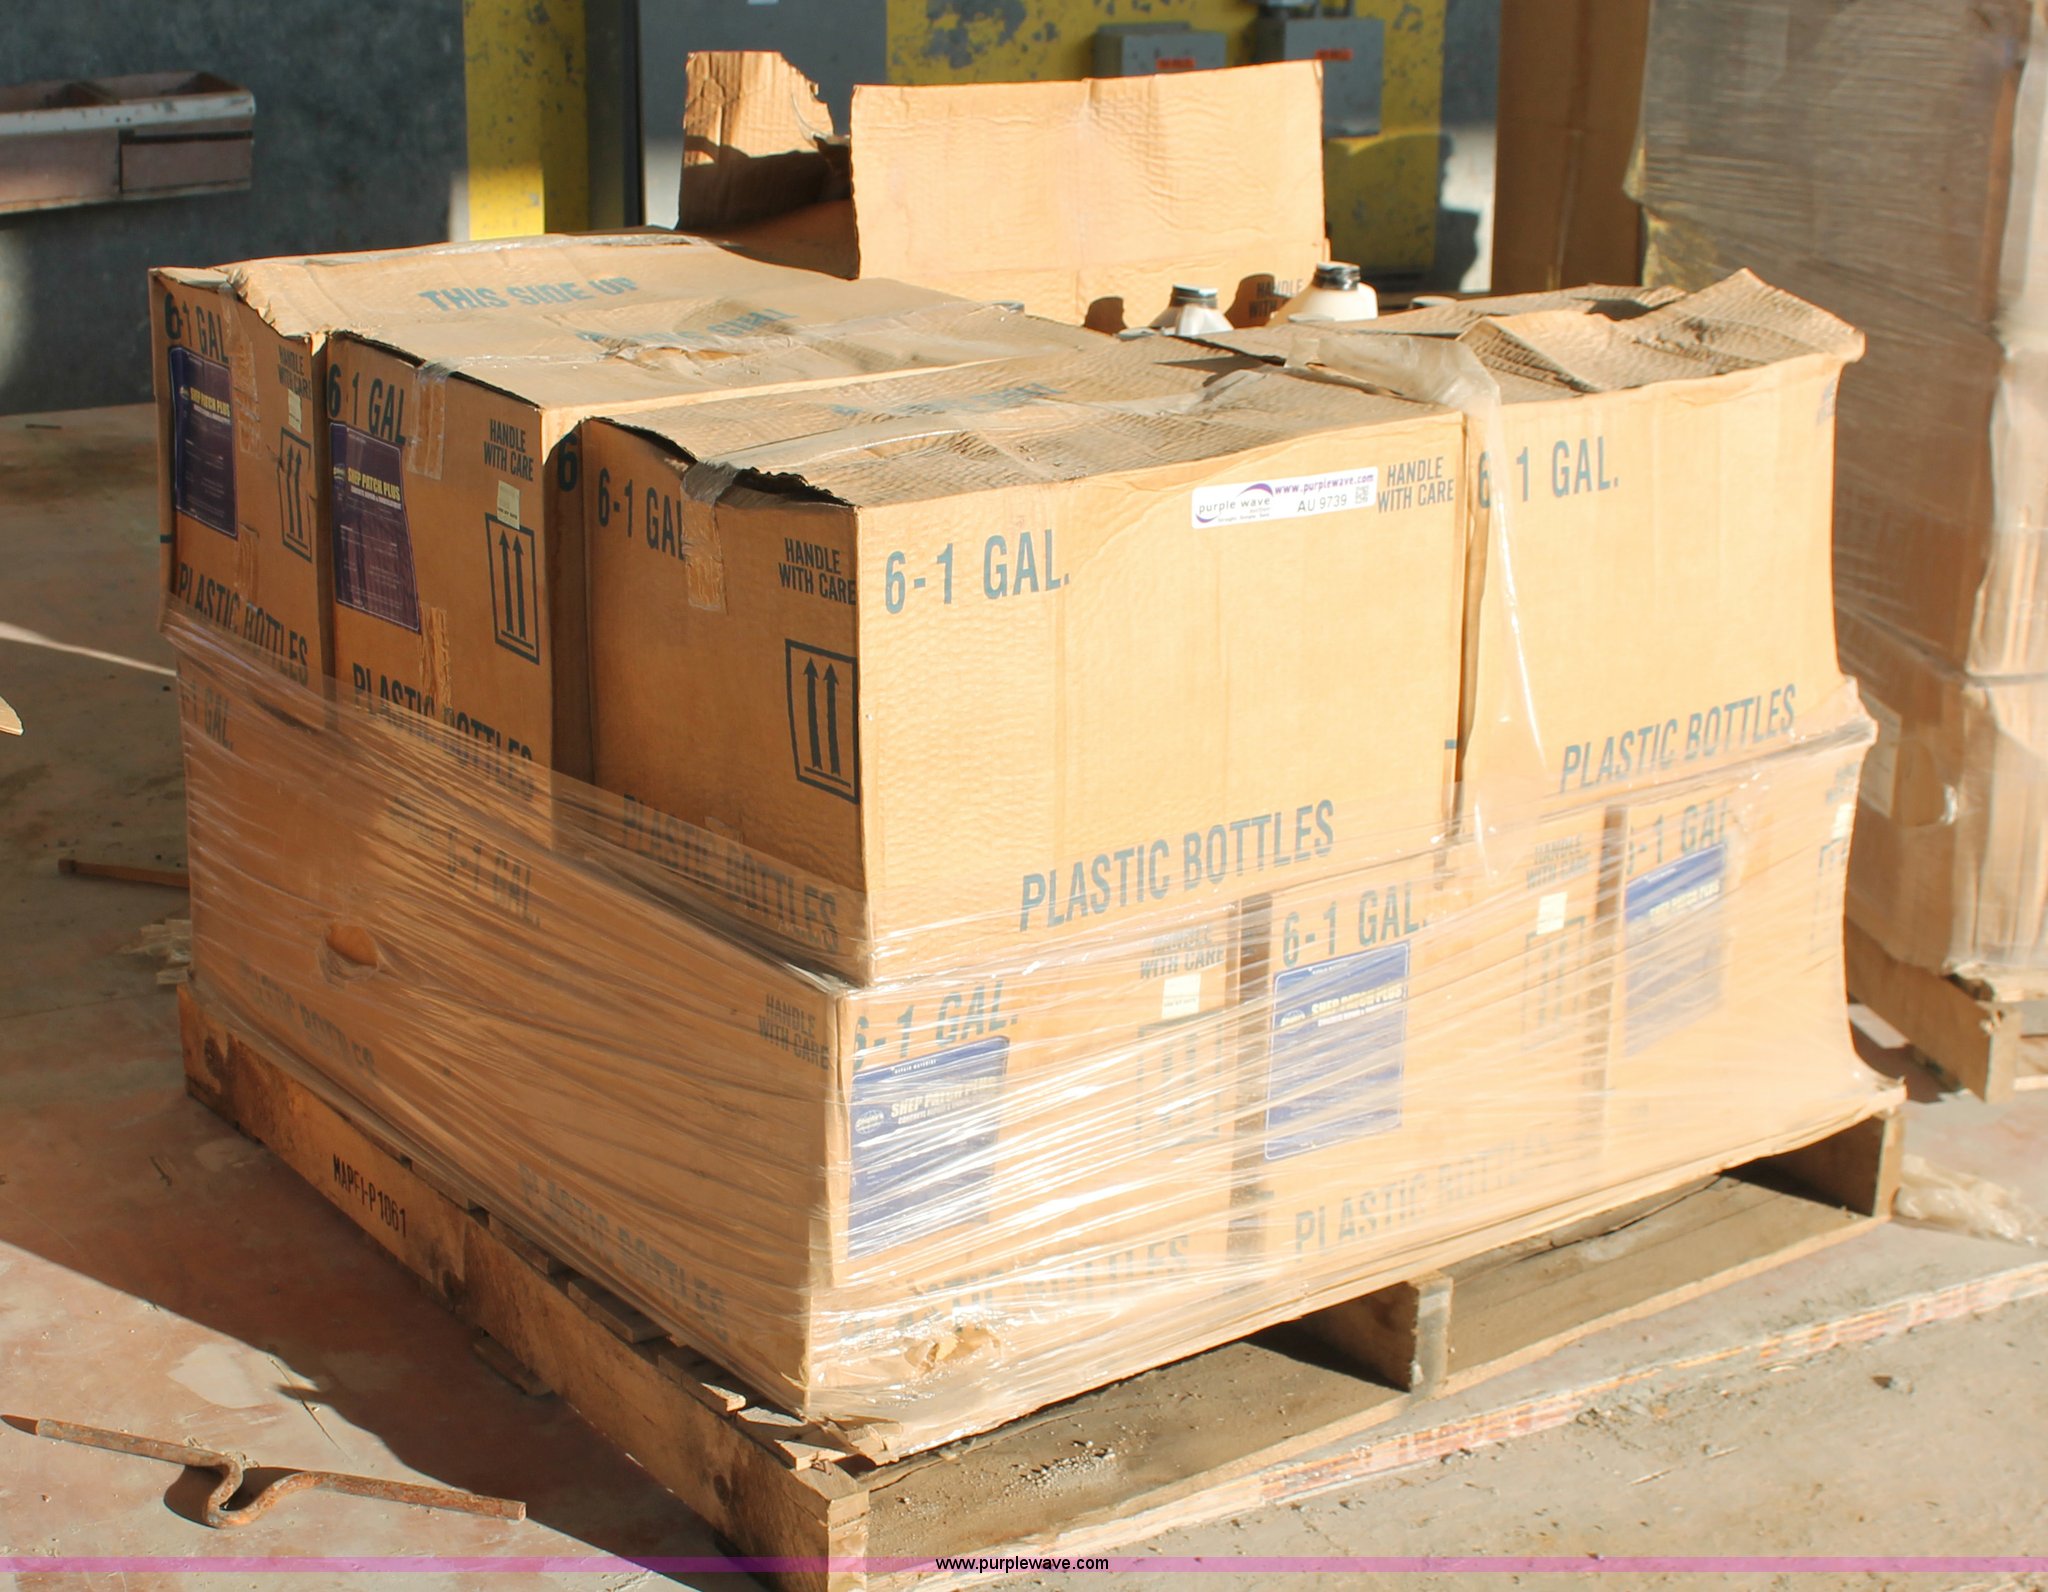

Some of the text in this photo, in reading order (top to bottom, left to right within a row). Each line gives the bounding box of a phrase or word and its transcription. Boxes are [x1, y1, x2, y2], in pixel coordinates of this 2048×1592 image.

[416, 287, 508, 312] THIS
[506, 281, 597, 306] SIDE
[489, 418, 526, 453] HANDLE
[484, 441, 534, 482] WITH CARE
[1387, 456, 1444, 487] HANDLE
[1477, 435, 1620, 509] 61 GAL.
[598, 467, 633, 538] 6-1
[1274, 473, 1375, 494] www.purplewave.com
[1297, 494, 1348, 513] AU 9739
[1377, 478, 1455, 513] WITH CARE
[1198, 500, 1236, 515] purple
[1240, 497, 1271, 508] wave
[783, 537, 842, 575] HANDLE
[885, 528, 1070, 615] 6-1 GAL.
[778, 562, 857, 605] WITH CARE
[179, 562, 309, 687] PLASTIC BOTTLES
[1561, 683, 1797, 794] PLASTIC BOTTLES
[1019, 798, 1335, 932] PLASTIC BOTTLES
[1282, 880, 1429, 968] 6-1 GAL.
[765, 993, 816, 1038] HANDLE
[758, 1015, 830, 1071] WITH CARE
